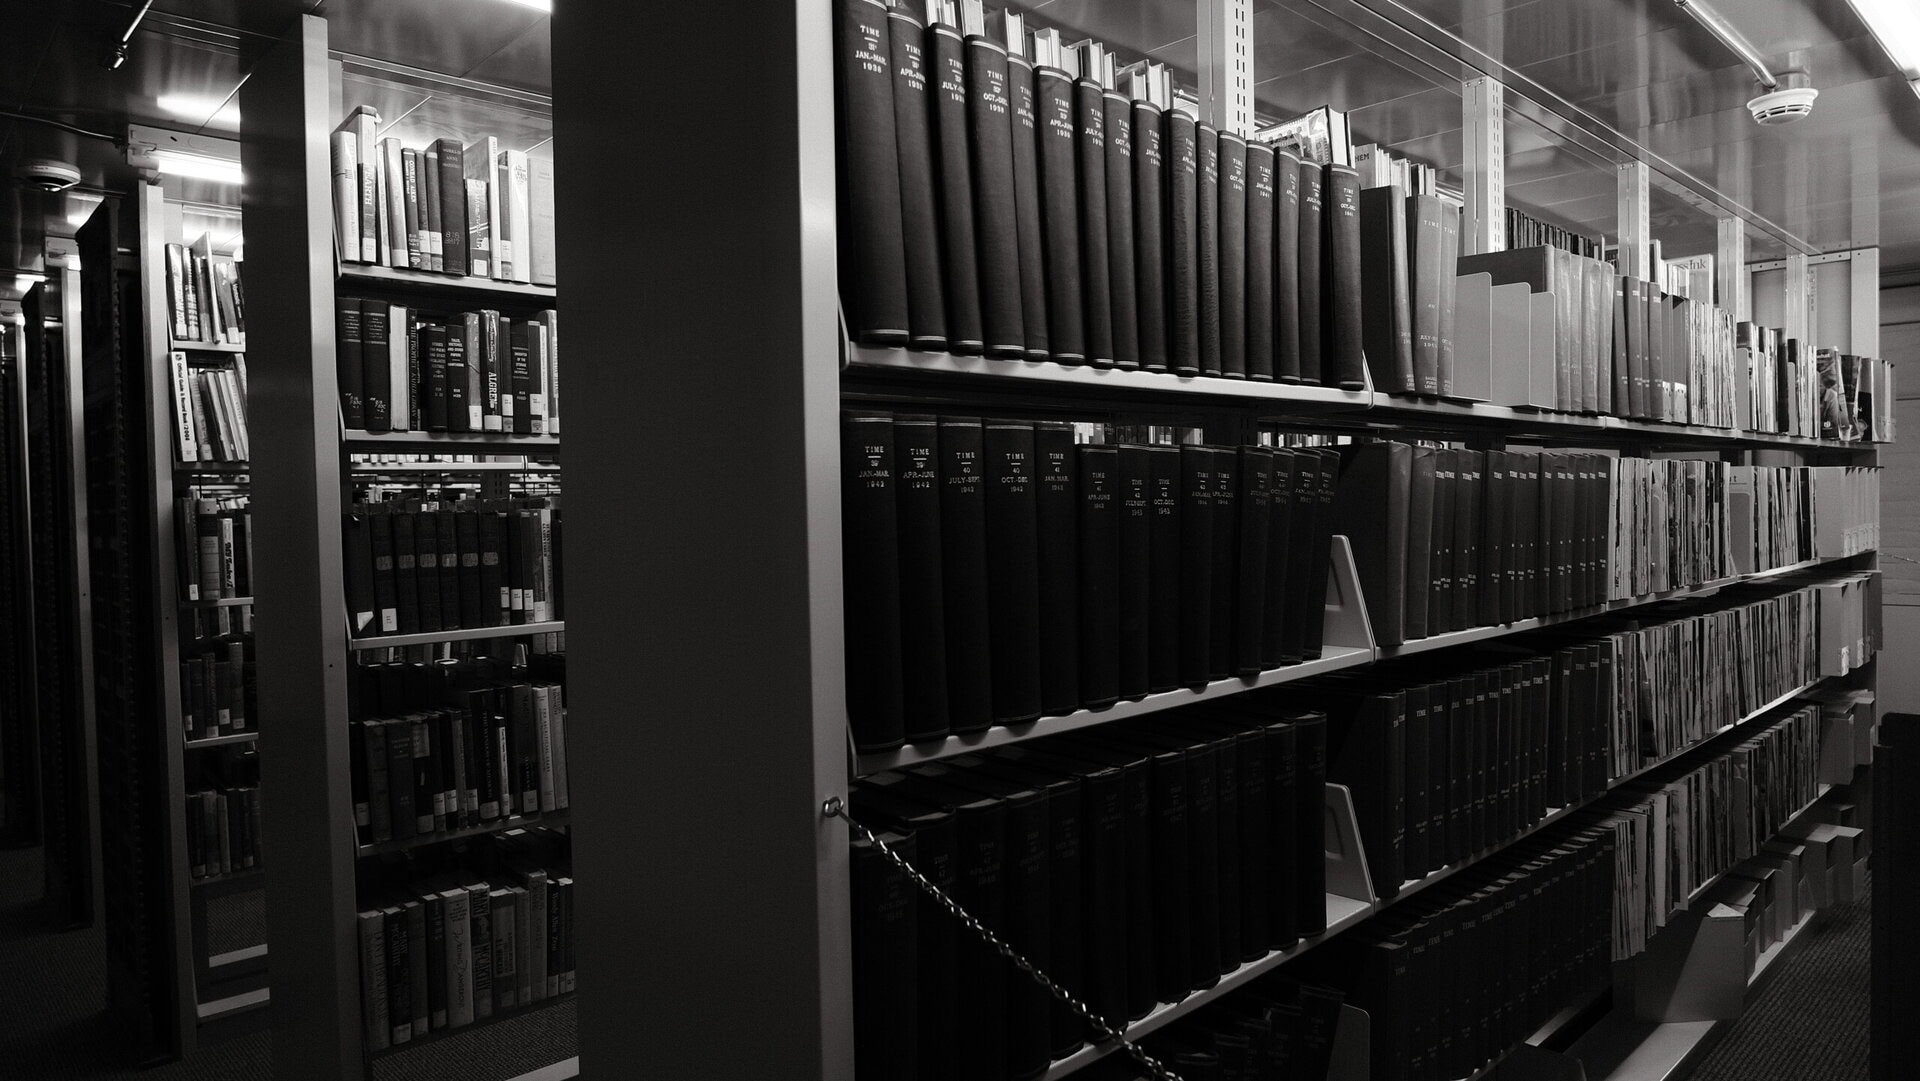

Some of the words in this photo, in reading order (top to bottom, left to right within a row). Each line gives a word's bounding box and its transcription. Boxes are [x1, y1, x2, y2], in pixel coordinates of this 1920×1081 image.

[860, 25, 880, 37] TIME
[905, 44, 921, 56] TIME
[863, 62, 882, 74] 1938
[986, 70, 1003, 81] TIME
[1054, 97, 1069, 109] TIME
[408, 160, 416, 183] CONRAD
[1423, 219, 1439, 228] TIME
[1444, 227, 1456, 235] TIME
[865, 446, 884, 454] TIME
[910, 448, 930, 456] TIME
[956, 451, 975, 459] TIME
[912, 481, 930, 489] 1942
